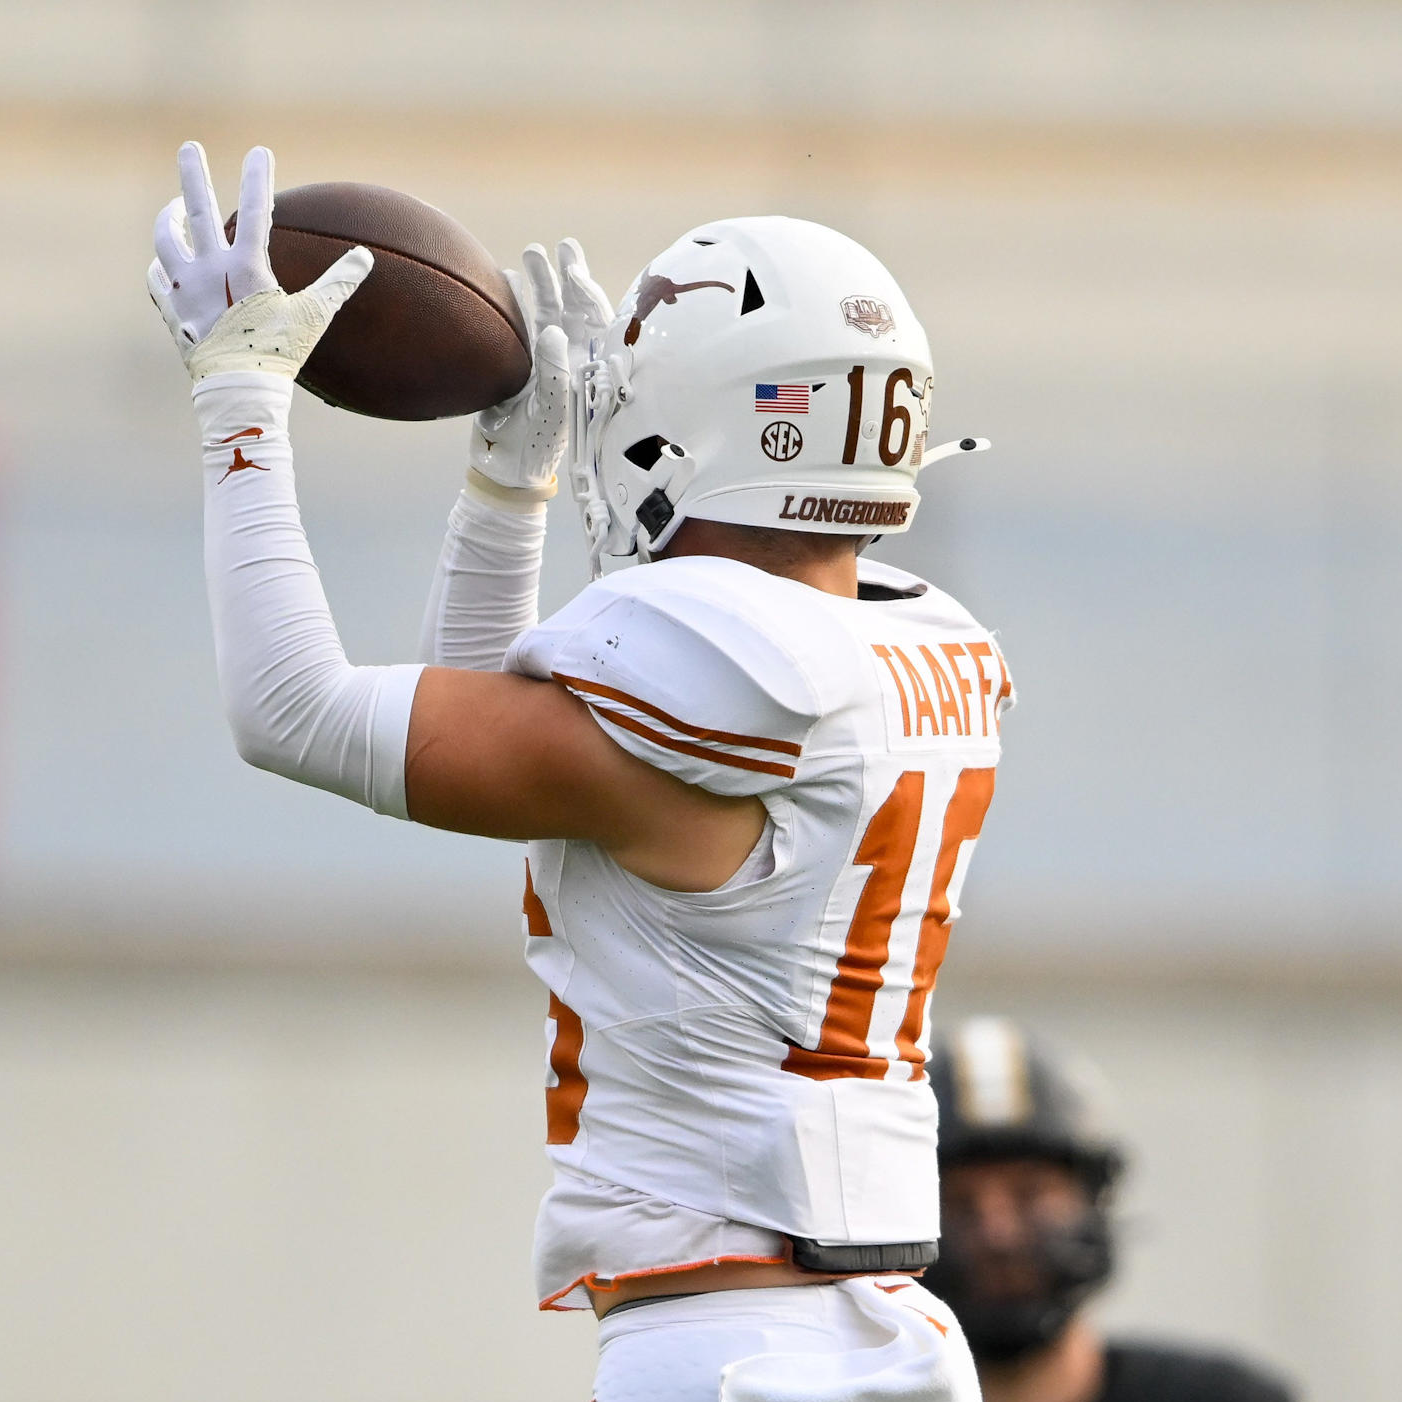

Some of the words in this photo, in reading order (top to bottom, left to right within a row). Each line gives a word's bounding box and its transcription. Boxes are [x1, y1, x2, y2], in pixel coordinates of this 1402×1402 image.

[841, 365, 914, 467] 16
[761, 420, 803, 462] SEC
[778, 495, 912, 526] LONGHORNS
